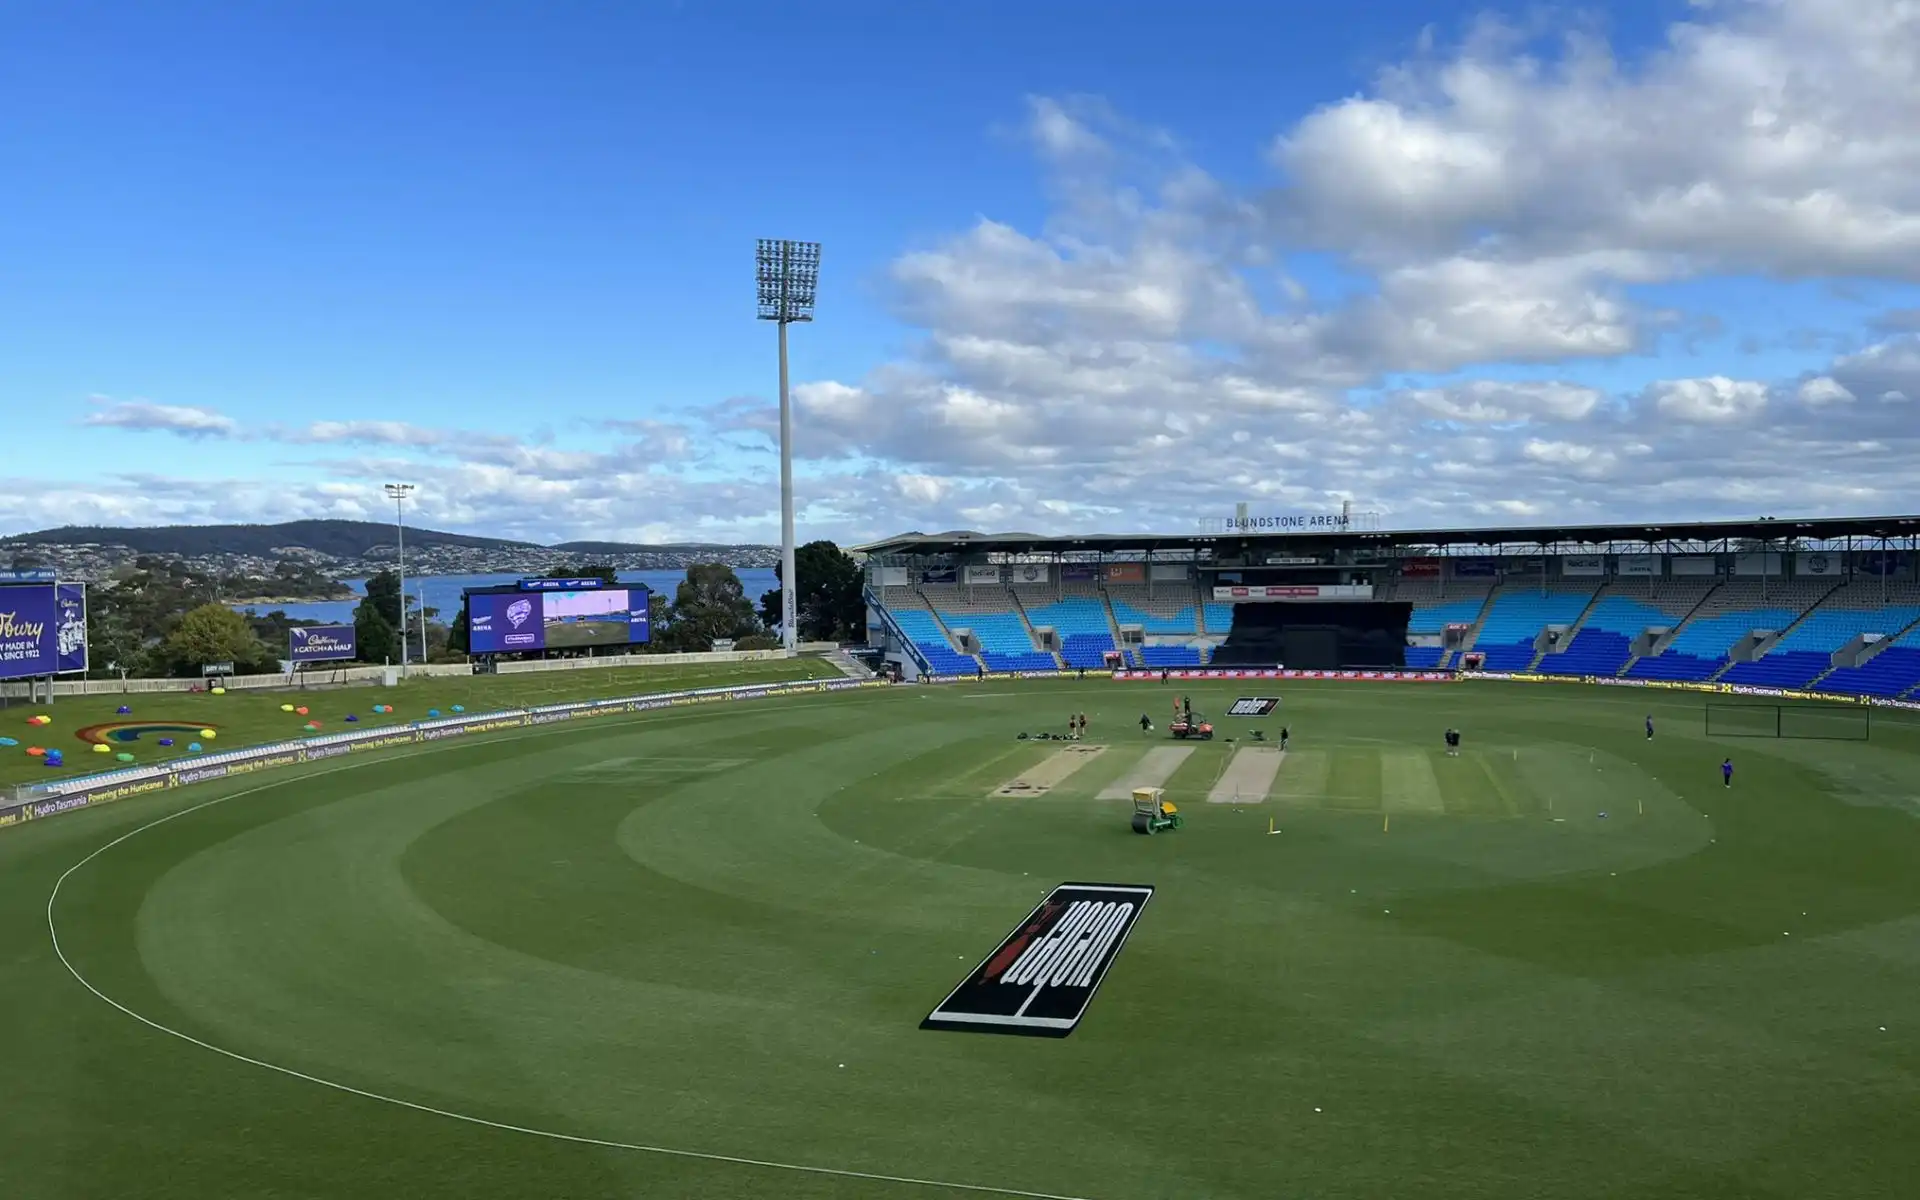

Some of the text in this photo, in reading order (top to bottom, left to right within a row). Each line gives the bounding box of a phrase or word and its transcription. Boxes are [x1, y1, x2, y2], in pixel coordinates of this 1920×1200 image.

[1226, 515, 1350, 528] BLUNDSTONE ARENA
[5, 642, 26, 651] MADE
[26, 641, 34, 650] IN
[299, 645, 323, 653] CATCH
[334, 644, 352, 652] HALF
[4, 650, 24, 660] SINCE
[25, 649, 40, 659] 1922
[1733, 685, 1752, 693] Hydro
[1753, 687, 1782, 696] Tasmania
[1822, 693, 1855, 702] Hurricanes
[1871, 697, 1891, 706] Hydro
[180, 772, 199, 785] Hydro
[199, 765, 227, 778] Tasmania
[227, 762, 253, 773] Powering
[264, 756, 294, 768] Hurricanes
[35, 780, 164, 817] Hydro Tasmania Powering the Hurricanes
